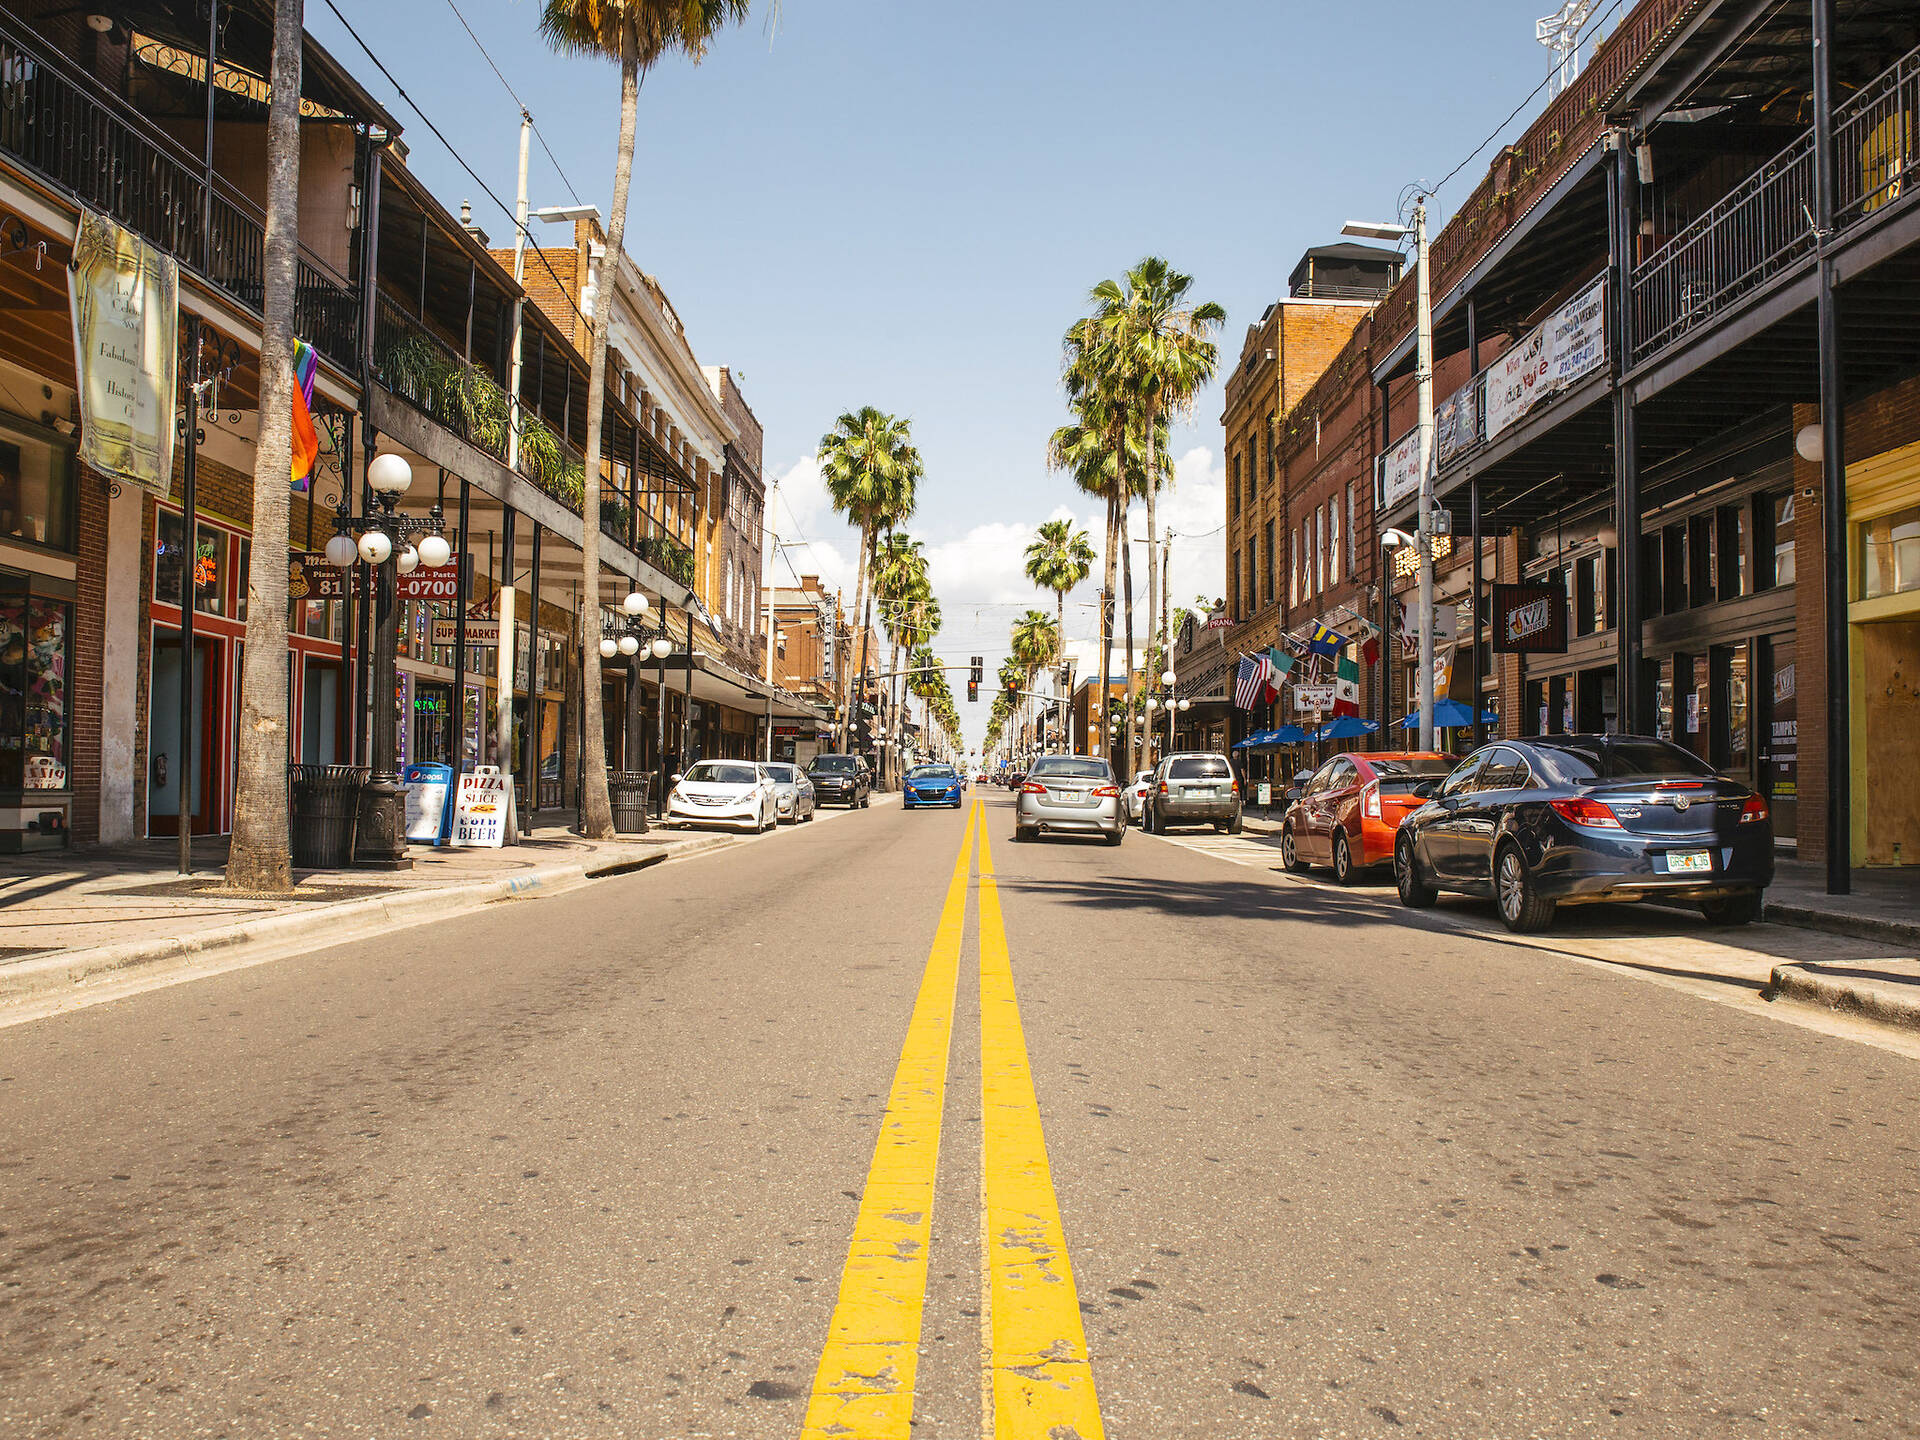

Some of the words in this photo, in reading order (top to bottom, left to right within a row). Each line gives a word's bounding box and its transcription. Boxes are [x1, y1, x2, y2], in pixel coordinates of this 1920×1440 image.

[312, 570, 336, 578] Pizza
[1209, 618, 1235, 628] PRANA
[435, 627, 500, 640] SUPEMARKET
[421, 773, 443, 782] pepsi
[463, 777, 504, 790] PIZZA
[465, 794, 497, 803] SLICE
[458, 827, 496, 840] BEER
